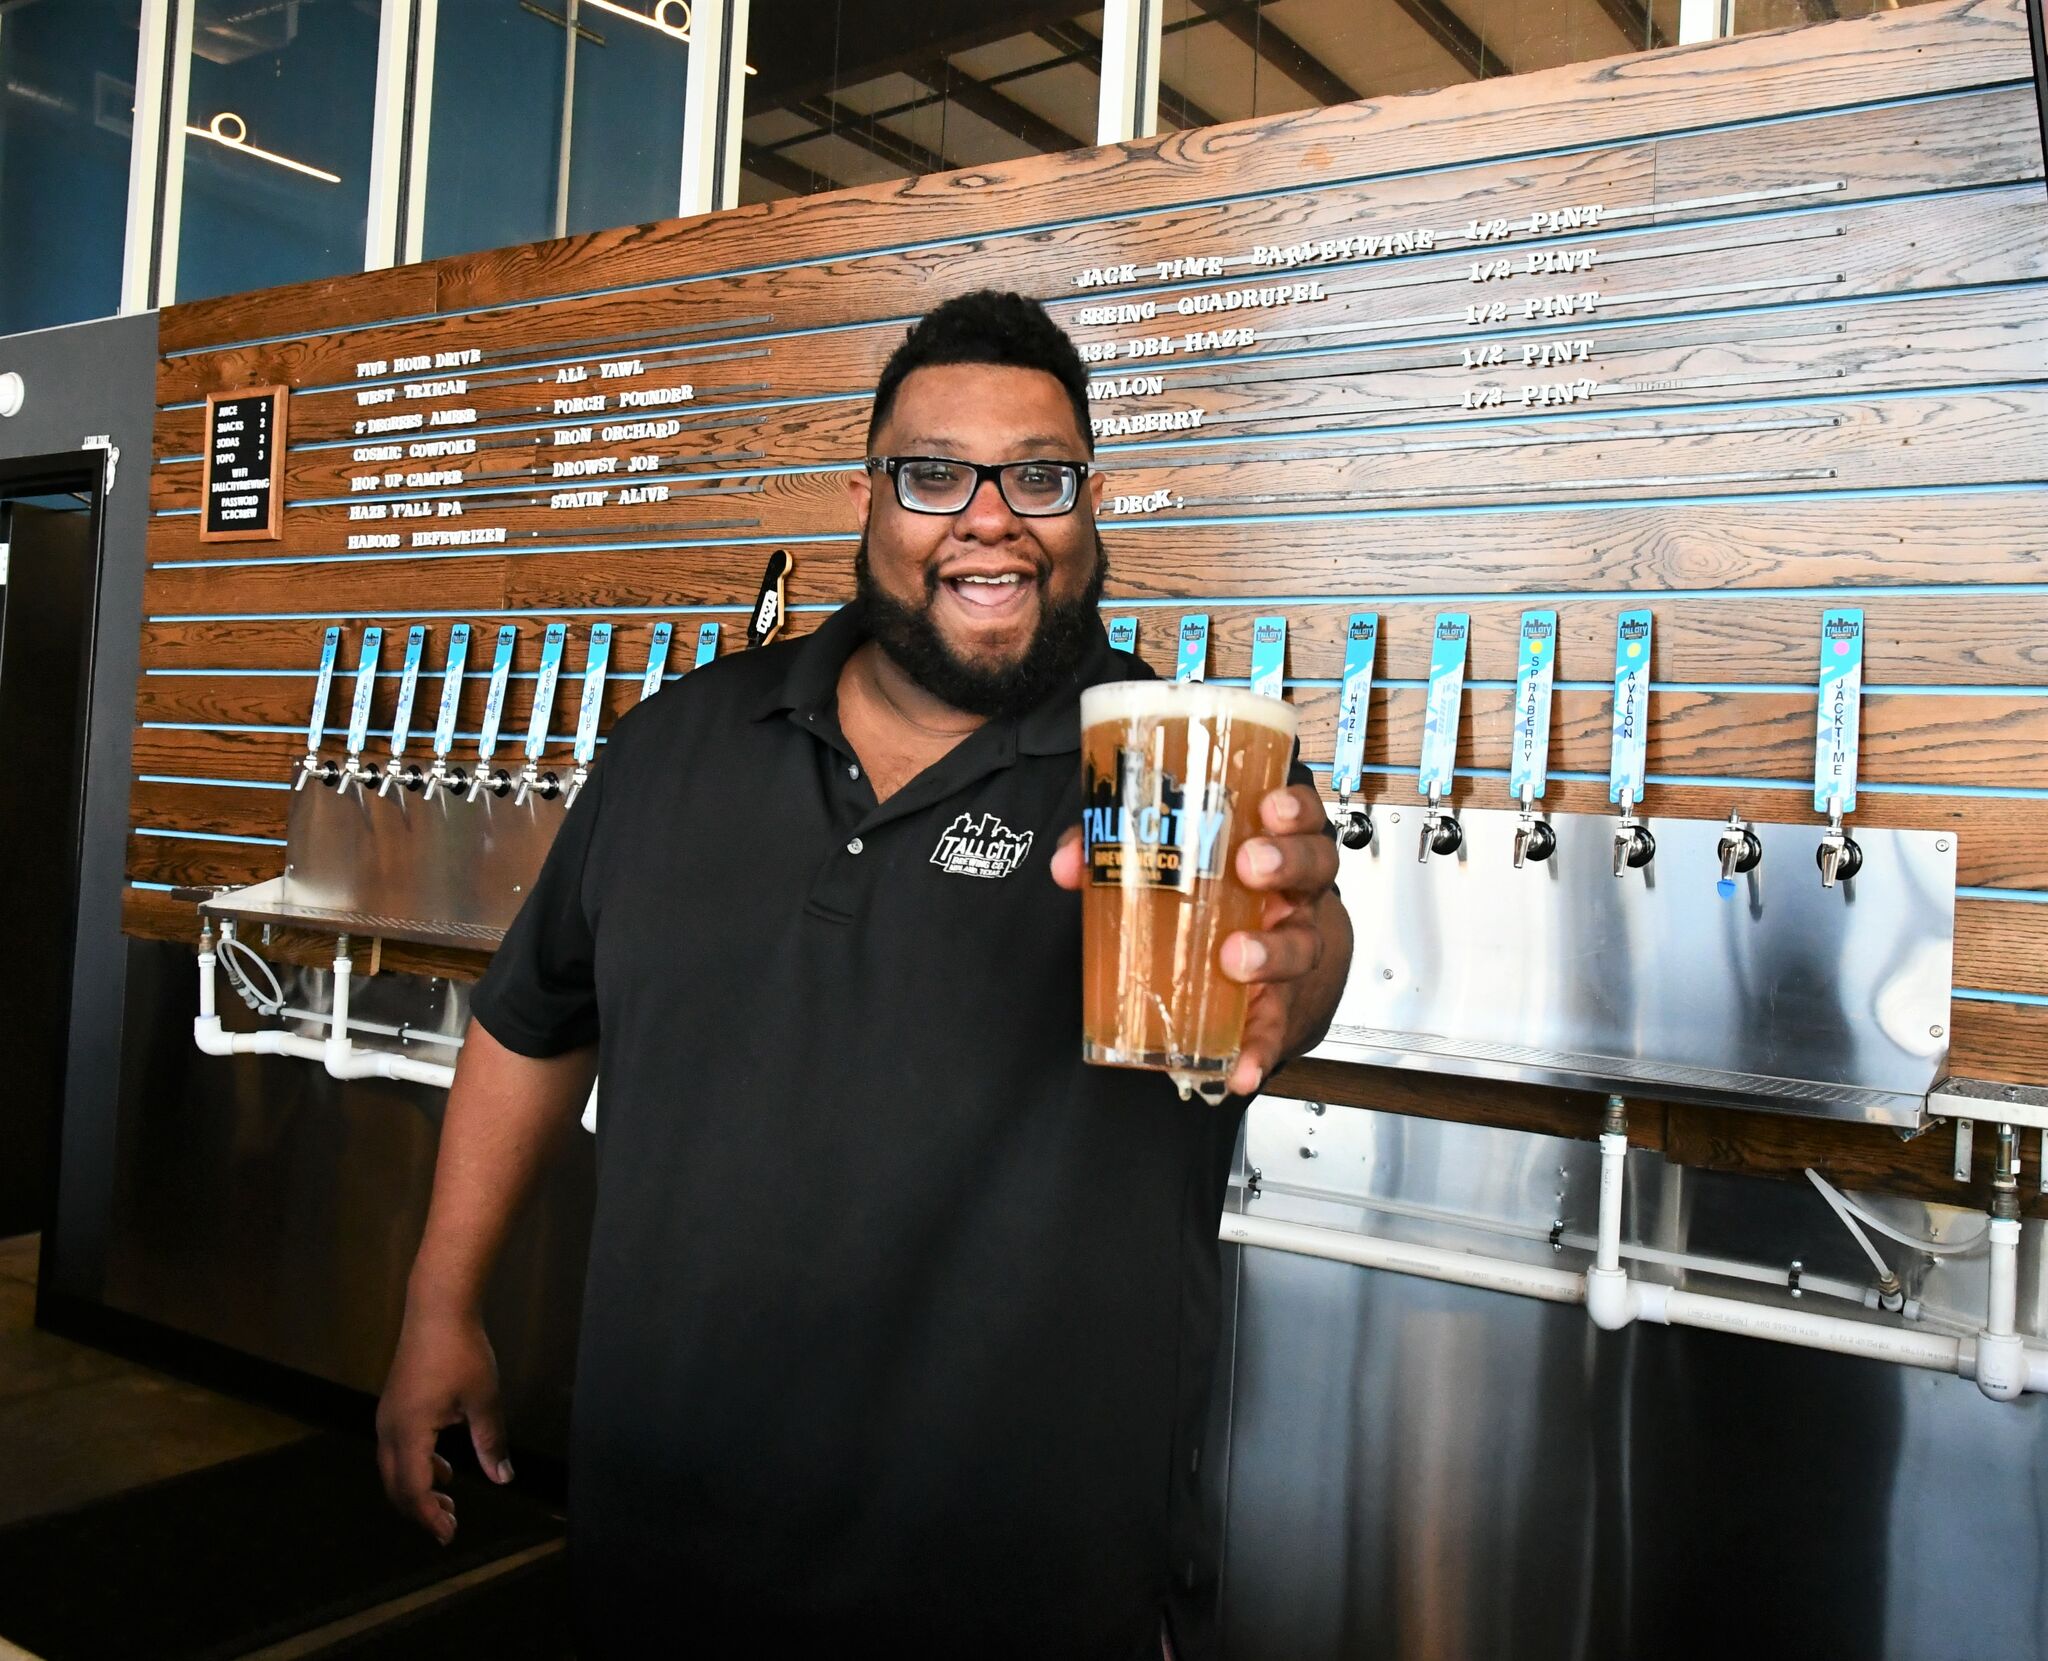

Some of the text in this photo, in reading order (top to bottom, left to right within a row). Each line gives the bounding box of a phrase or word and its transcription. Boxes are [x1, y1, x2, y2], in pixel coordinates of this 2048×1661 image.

[1077, 204, 1603, 288] JACK TIME BARLEYWINE 1/2 PINT
[1079, 248, 1597, 325] SEEING QUADRUPEL 1/2 PINT
[1128, 337, 1175, 358] DBL
[1184, 327, 1256, 353] HAZE
[1464, 302, 1508, 325] 1/2
[1524, 291, 1600, 320] PINT
[357, 349, 481, 377] FIVE HOUR DRIVE
[1460, 344, 1505, 368] 1/2
[1521, 339, 1595, 367] PINT
[556, 360, 645, 384] ALL YAWL
[357, 388, 395, 406] WEST
[553, 384, 694, 415] PORCH POUNDER
[1090, 408, 1206, 437] PRABERRY
[1520, 377, 1598, 407] PINT
[218, 402, 267, 418] JUICE 2
[367, 414, 423, 433] DEGREES
[430, 408, 477, 426] AMBER
[216, 418, 266, 434] SNACKS 2
[553, 420, 680, 446] IRON ORCHARD
[216, 434, 265, 449] SODAS 2
[353, 439, 477, 462] COSMIC COWPOKE
[257, 450, 264, 461] 3
[552, 455, 660, 478] DROWSY JOE
[231, 467, 249, 479] WIFI
[351, 471, 463, 492] HOP UP CAMPER
[220, 496, 259, 508] PASSWORD
[551, 486, 669, 509] STAYIN' ALIVE
[349, 501, 463, 521] HAZE Y'ALL IPA
[412, 528, 507, 547] HEFEWEIZEN
[540, 661, 553, 712] COSMIC
[1524, 656, 1540, 762] SPRABERRY
[1623, 671, 1636, 739] AVALON
[1346, 693, 1358, 743] HAZE
[1833, 679, 1845, 776] JACKTIME
[940, 836, 985, 861] TALL
[951, 857, 991, 869] BREWING
